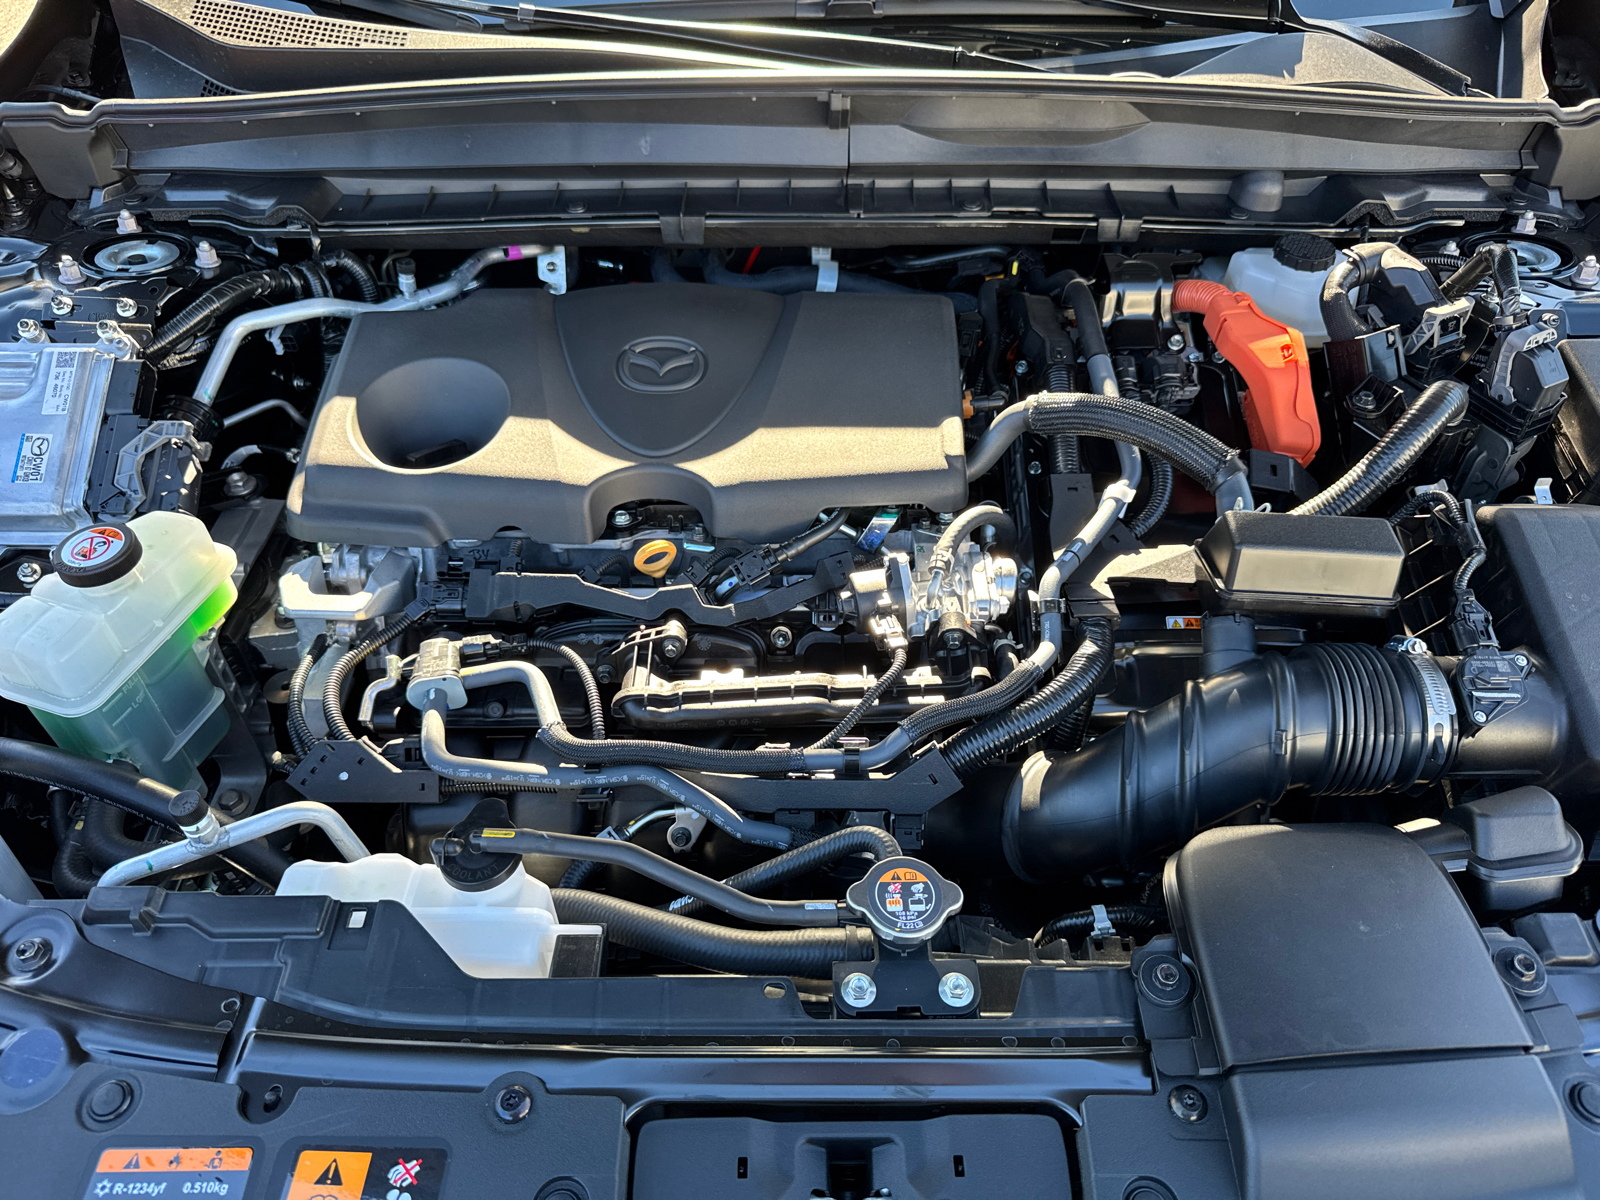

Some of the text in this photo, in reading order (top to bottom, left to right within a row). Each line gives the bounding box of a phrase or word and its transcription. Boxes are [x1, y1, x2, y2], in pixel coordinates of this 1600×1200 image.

[30, 456, 43, 481] CW01
[446, 862, 500, 880] COOLANT
[112, 1181, 229, 1197] R-1234yf 0.510kg
